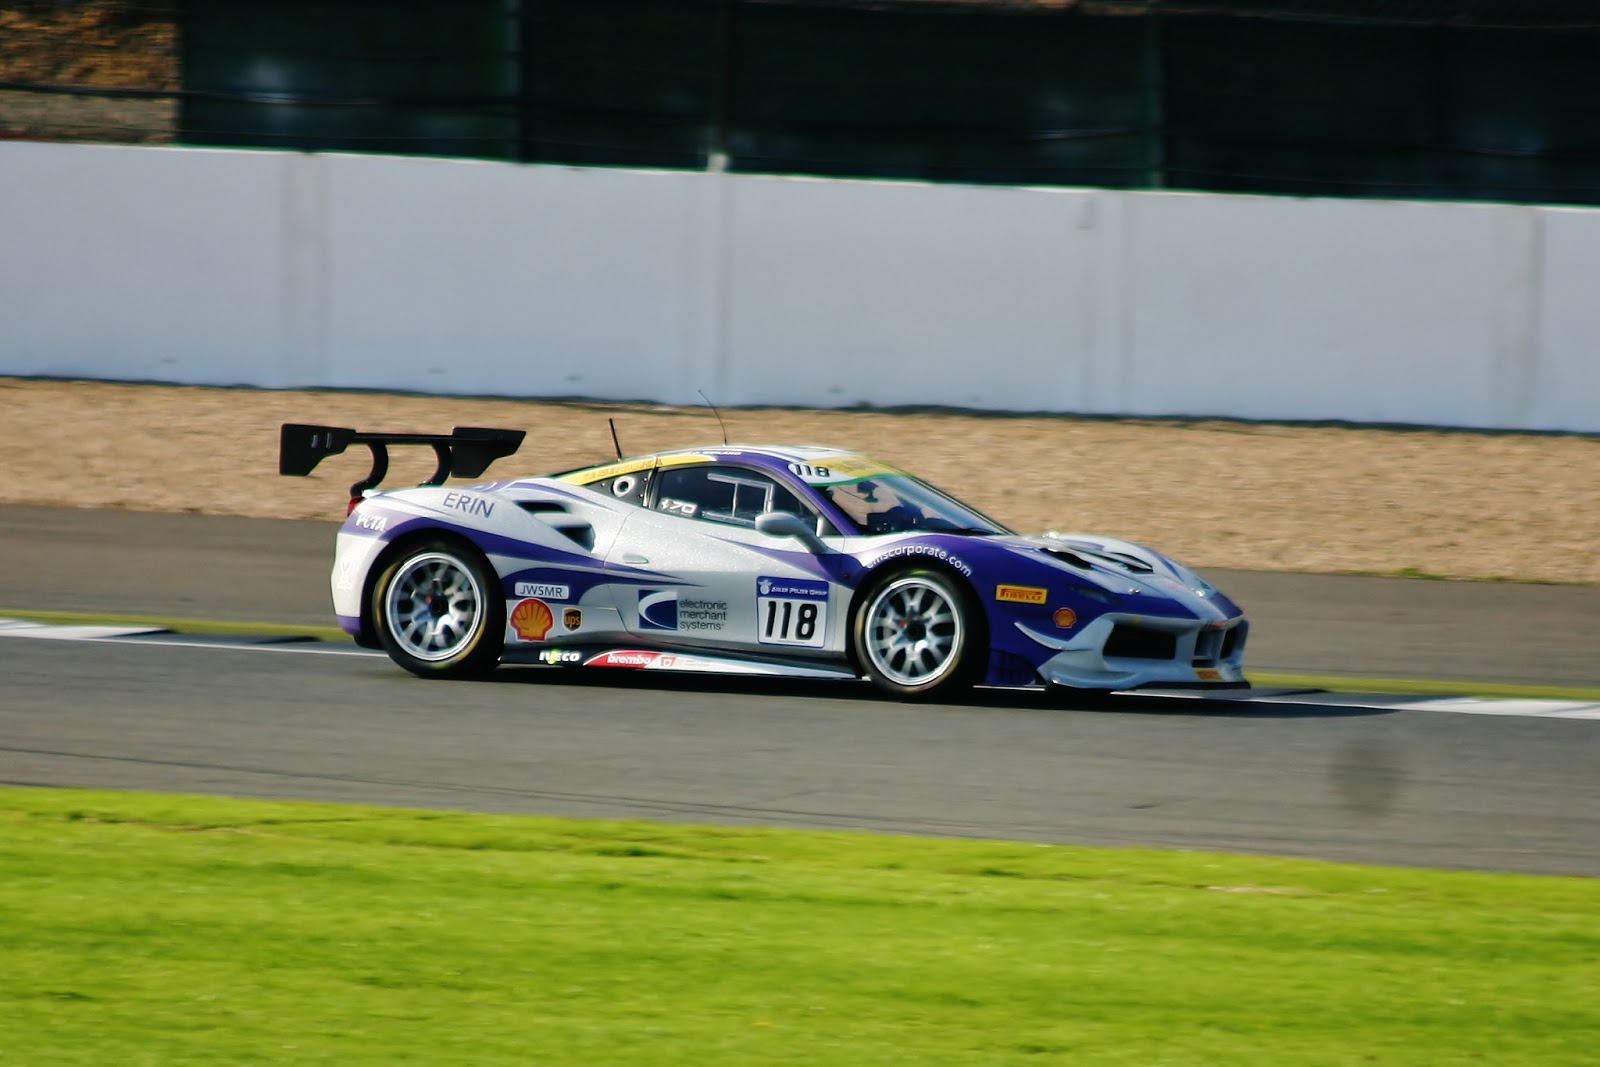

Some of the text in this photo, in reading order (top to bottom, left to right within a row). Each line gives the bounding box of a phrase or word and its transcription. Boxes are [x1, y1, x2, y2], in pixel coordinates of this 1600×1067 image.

[794, 464, 830, 478] 118
[443, 492, 495, 519] ERIN
[520, 585, 563, 597] JWSMR
[679, 599, 727, 610] electronic
[680, 610, 726, 620] merchant
[765, 600, 818, 641] 118
[680, 621, 722, 631] systems
[607, 653, 650, 665] brembo
